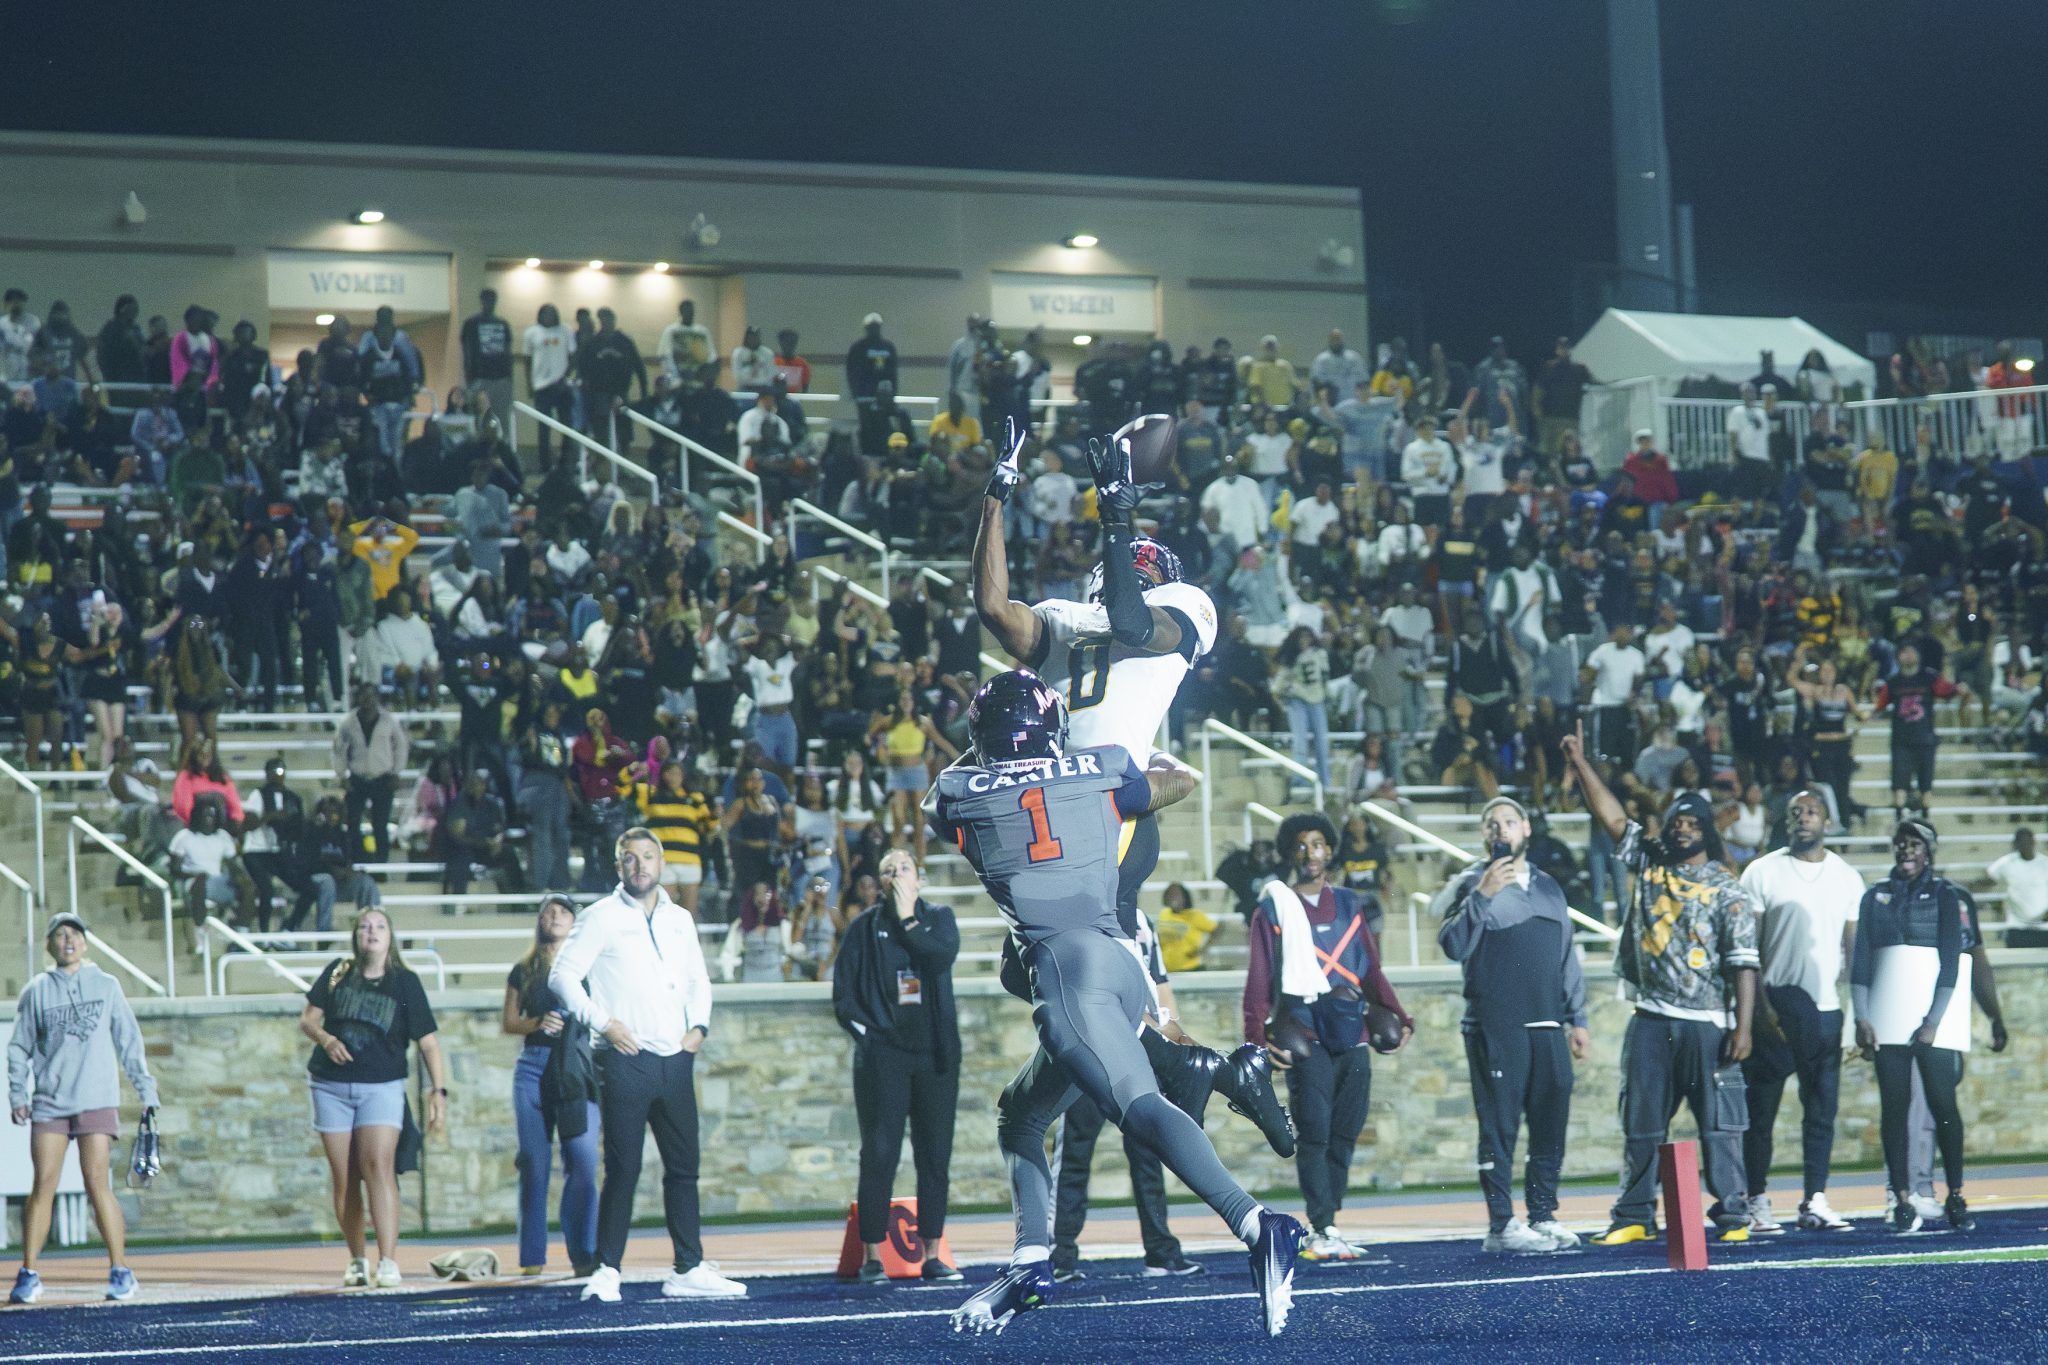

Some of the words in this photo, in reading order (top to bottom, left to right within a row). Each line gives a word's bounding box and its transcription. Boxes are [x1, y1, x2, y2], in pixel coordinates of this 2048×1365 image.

[309, 271, 405, 294] WOMEN
[1029, 294, 1115, 314] WOMEN
[1018, 786, 1065, 864] 1
[887, 1205, 923, 1264] G
